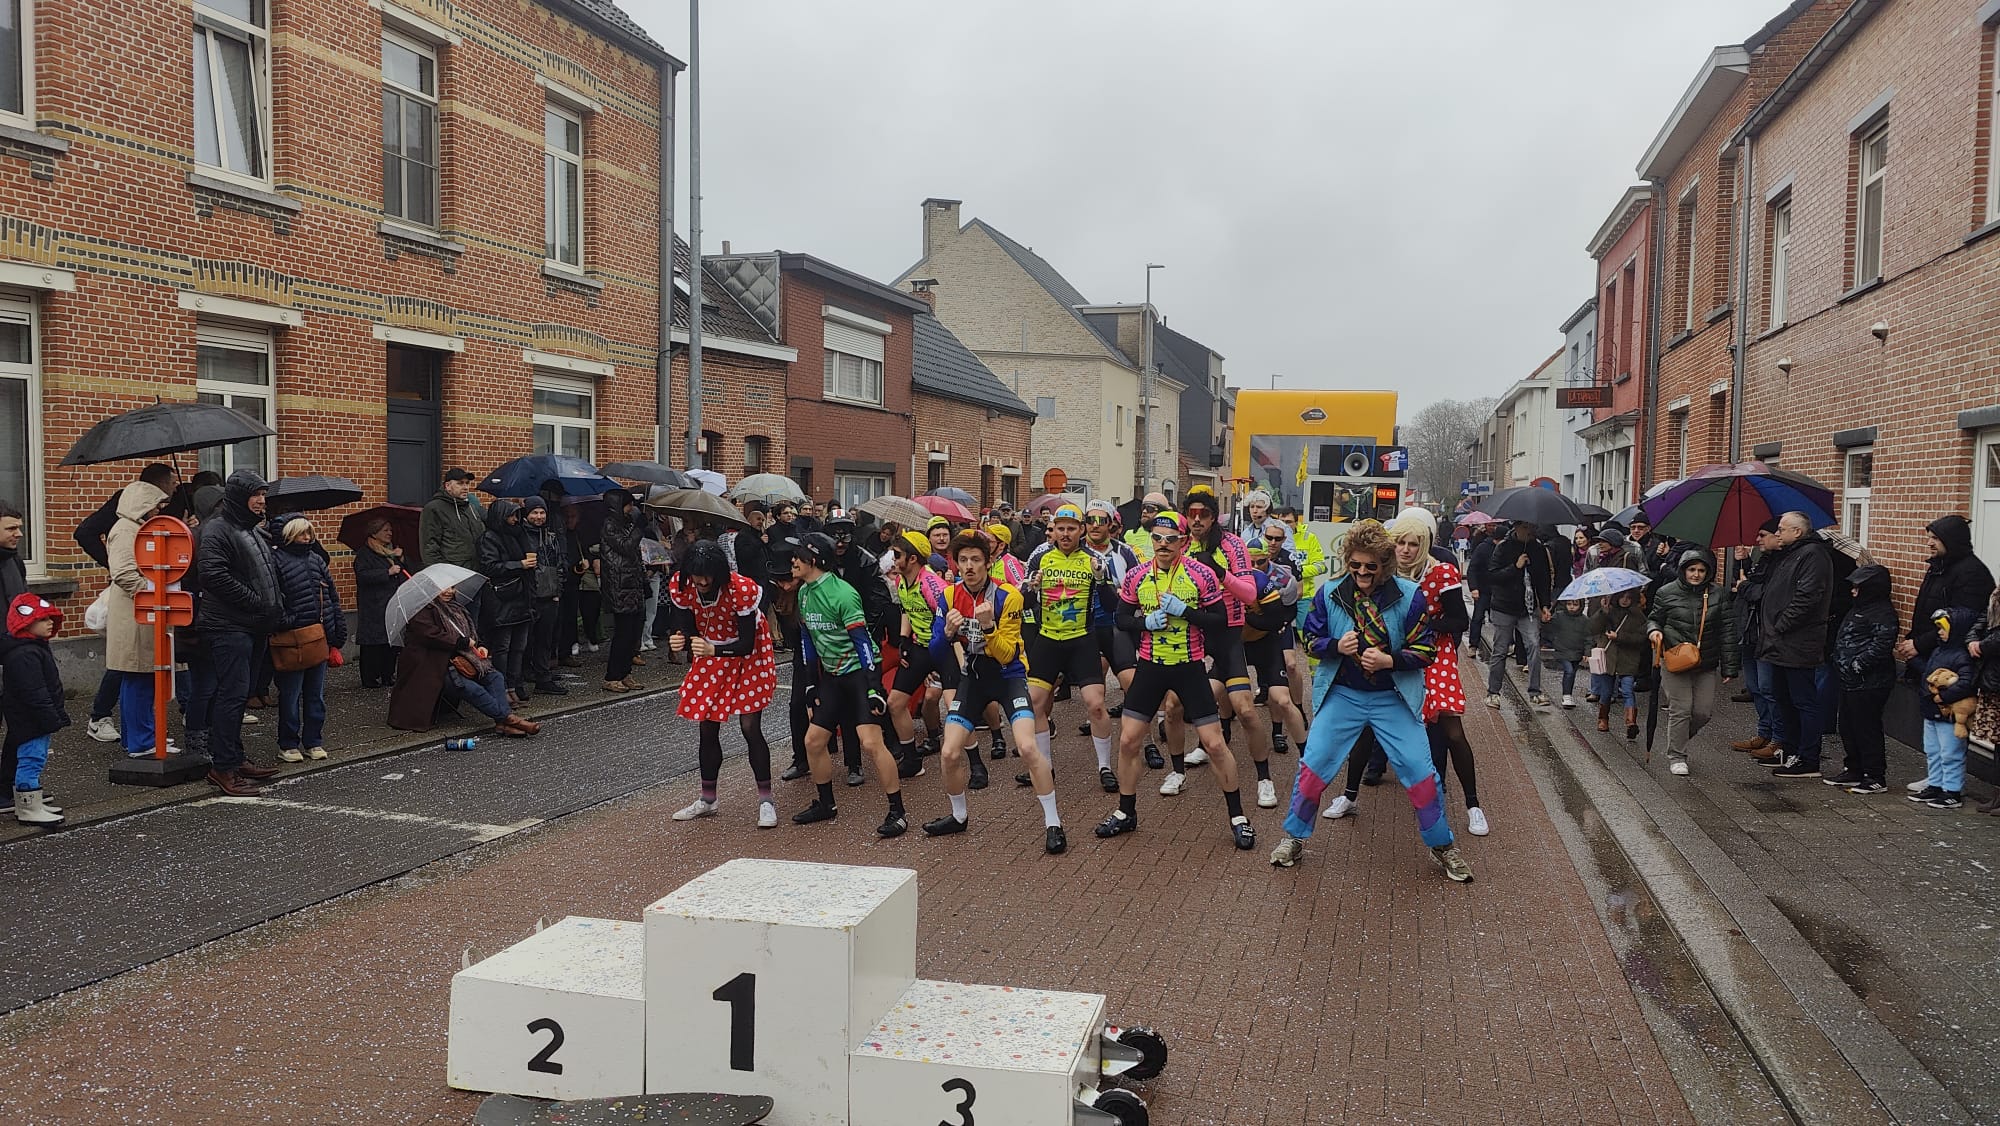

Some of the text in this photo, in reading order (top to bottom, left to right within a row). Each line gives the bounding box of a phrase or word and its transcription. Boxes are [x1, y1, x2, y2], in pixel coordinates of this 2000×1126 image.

[527, 1018, 565, 1076] 2
[713, 973, 756, 1072] 1
[942, 1078, 977, 1126] 3
